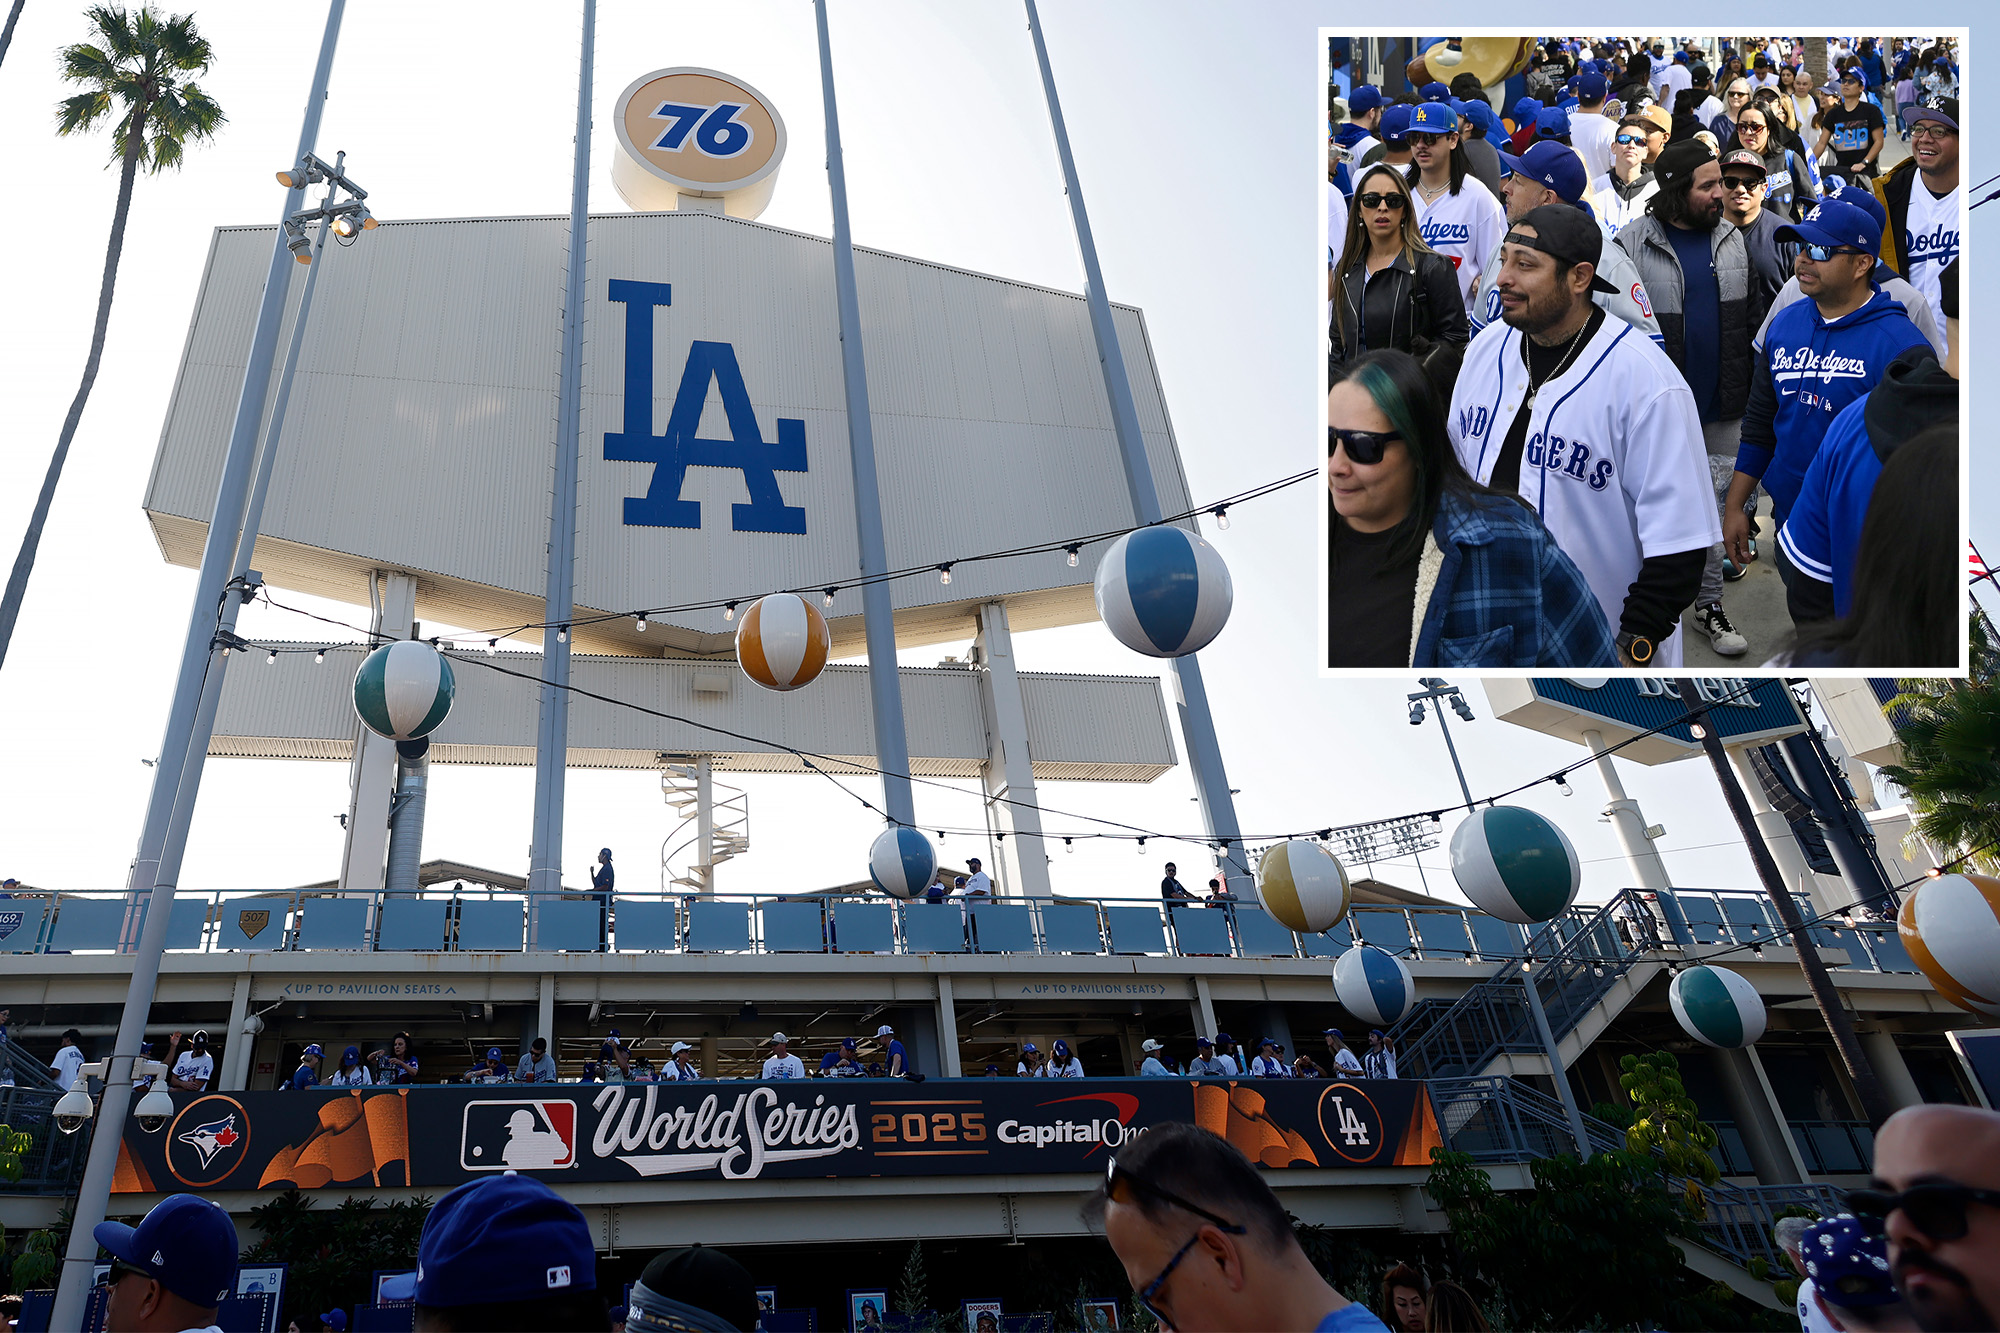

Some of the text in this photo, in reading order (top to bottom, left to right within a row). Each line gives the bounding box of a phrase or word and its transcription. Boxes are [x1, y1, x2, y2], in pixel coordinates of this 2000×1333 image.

[1416, 107, 1427, 122] LA
[648, 100, 754, 159] 76
[1834, 122, 1869, 149] Sup
[1805, 203, 1822, 222] LA
[1772, 347, 1793, 371] Los
[603, 278, 808, 536] LA
[244, 912, 264, 922] 507
[295, 984, 441, 994] UP TO PAVILION SEATS
[1034, 984, 1157, 994] UP TO PAVILION SEATS
[592, 1085, 859, 1179] World Series
[871, 1113, 987, 1143] 2025
[1331, 1096, 1370, 1146] LA
[269, 1272, 277, 1285] B
